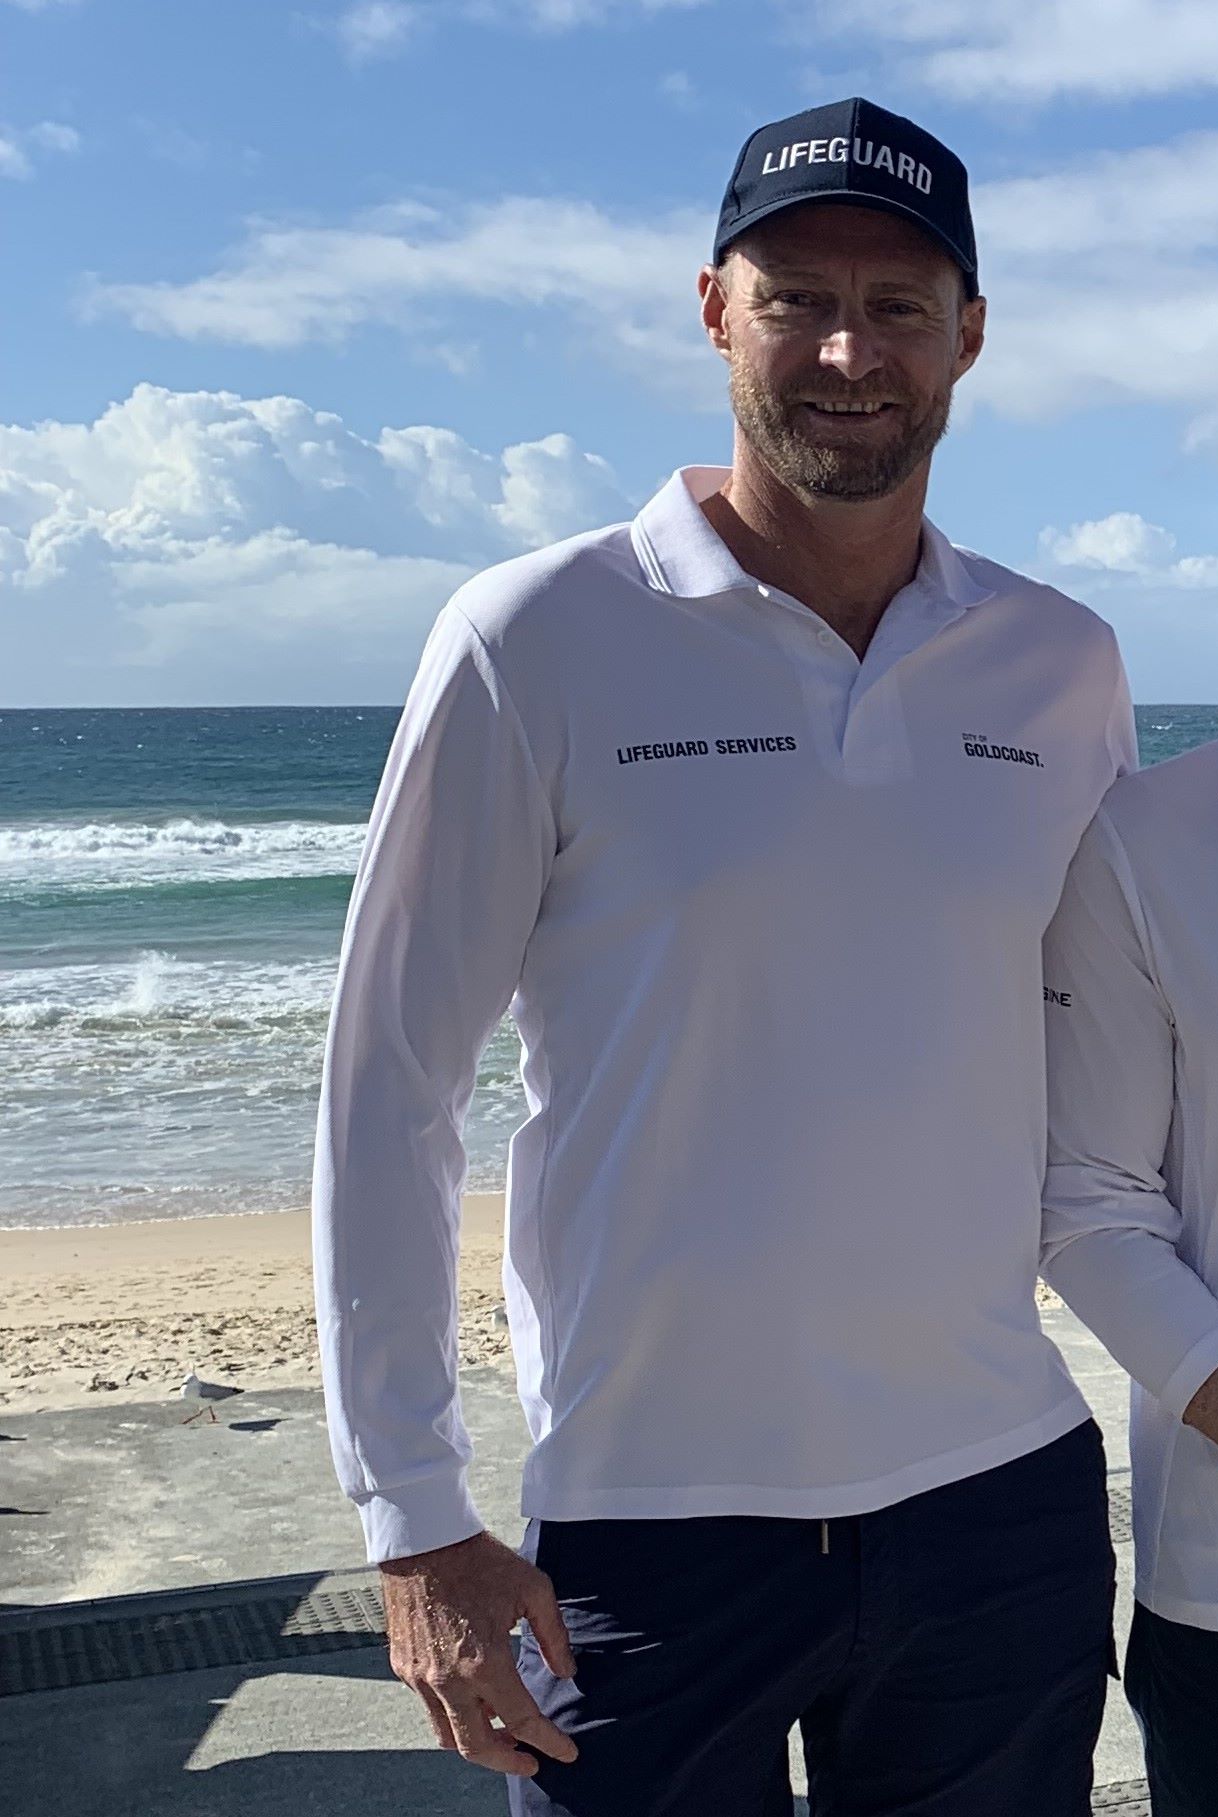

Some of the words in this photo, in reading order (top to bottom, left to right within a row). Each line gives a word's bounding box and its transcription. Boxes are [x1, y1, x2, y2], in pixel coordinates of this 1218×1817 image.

[762, 137, 932, 195] LIFEGUARD
[617, 740, 709, 764] LIFEGUARD
[715, 736, 797, 754] SERVICES
[964, 742, 1044, 768] GOLDCOAST.
